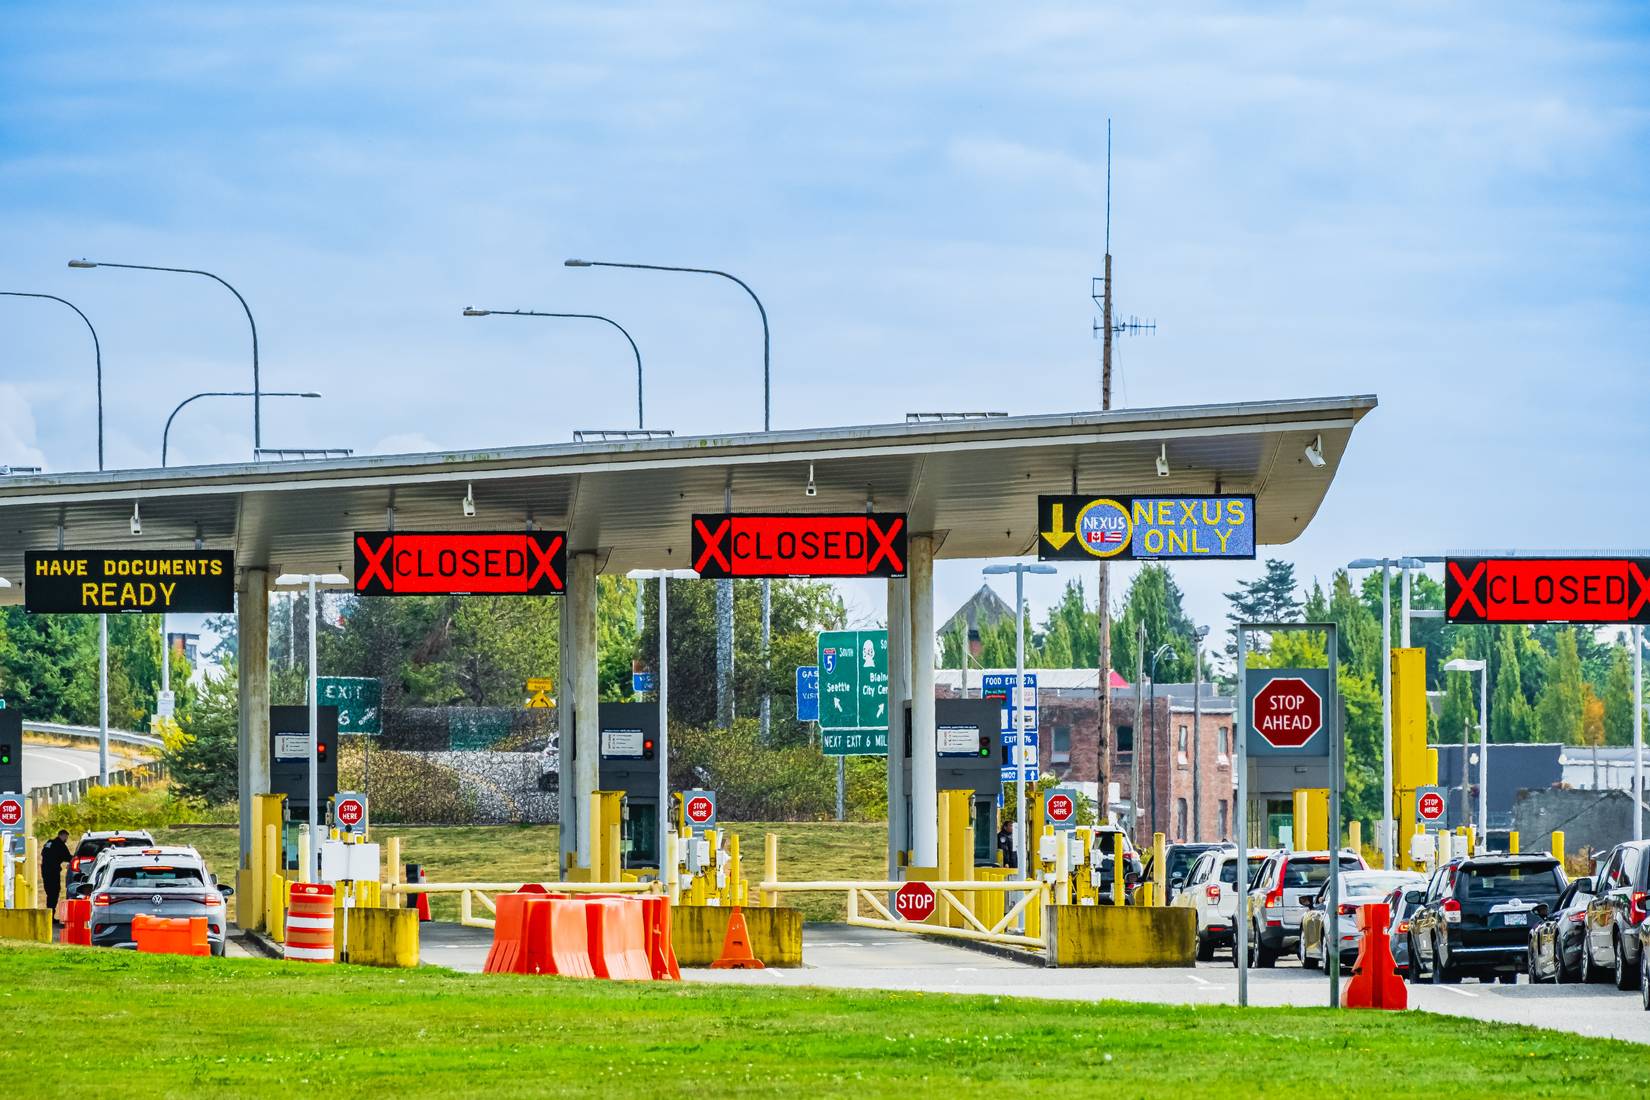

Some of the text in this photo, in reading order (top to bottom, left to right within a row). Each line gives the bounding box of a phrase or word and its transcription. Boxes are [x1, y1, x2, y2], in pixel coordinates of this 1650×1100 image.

[1133, 501, 1245, 526] NEXUS
[1083, 516, 1126, 530] NEXUS
[733, 531, 864, 559] CLOSED
[1144, 529, 1233, 553] ONLY
[35, 559, 223, 576] HAVE DOCUMENTS
[395, 549, 525, 577] CLOSED
[81, 582, 176, 606] READY
[1489, 575, 1625, 605] CLOSED
[826, 655, 833, 674] 5
[827, 682, 850, 693] Seattle
[985, 677, 1002, 686] FOOD
[325, 685, 362, 700] EXIT
[863, 685, 875, 698] City
[1269, 695, 1305, 711] STOP
[1262, 715, 1312, 730] AHEAD
[824, 735, 888, 748] NEXT EXIT 6 MIL
[343, 804, 358, 812] STOP
[342, 812, 358, 820] HERE
[898, 894, 933, 909] STOP
